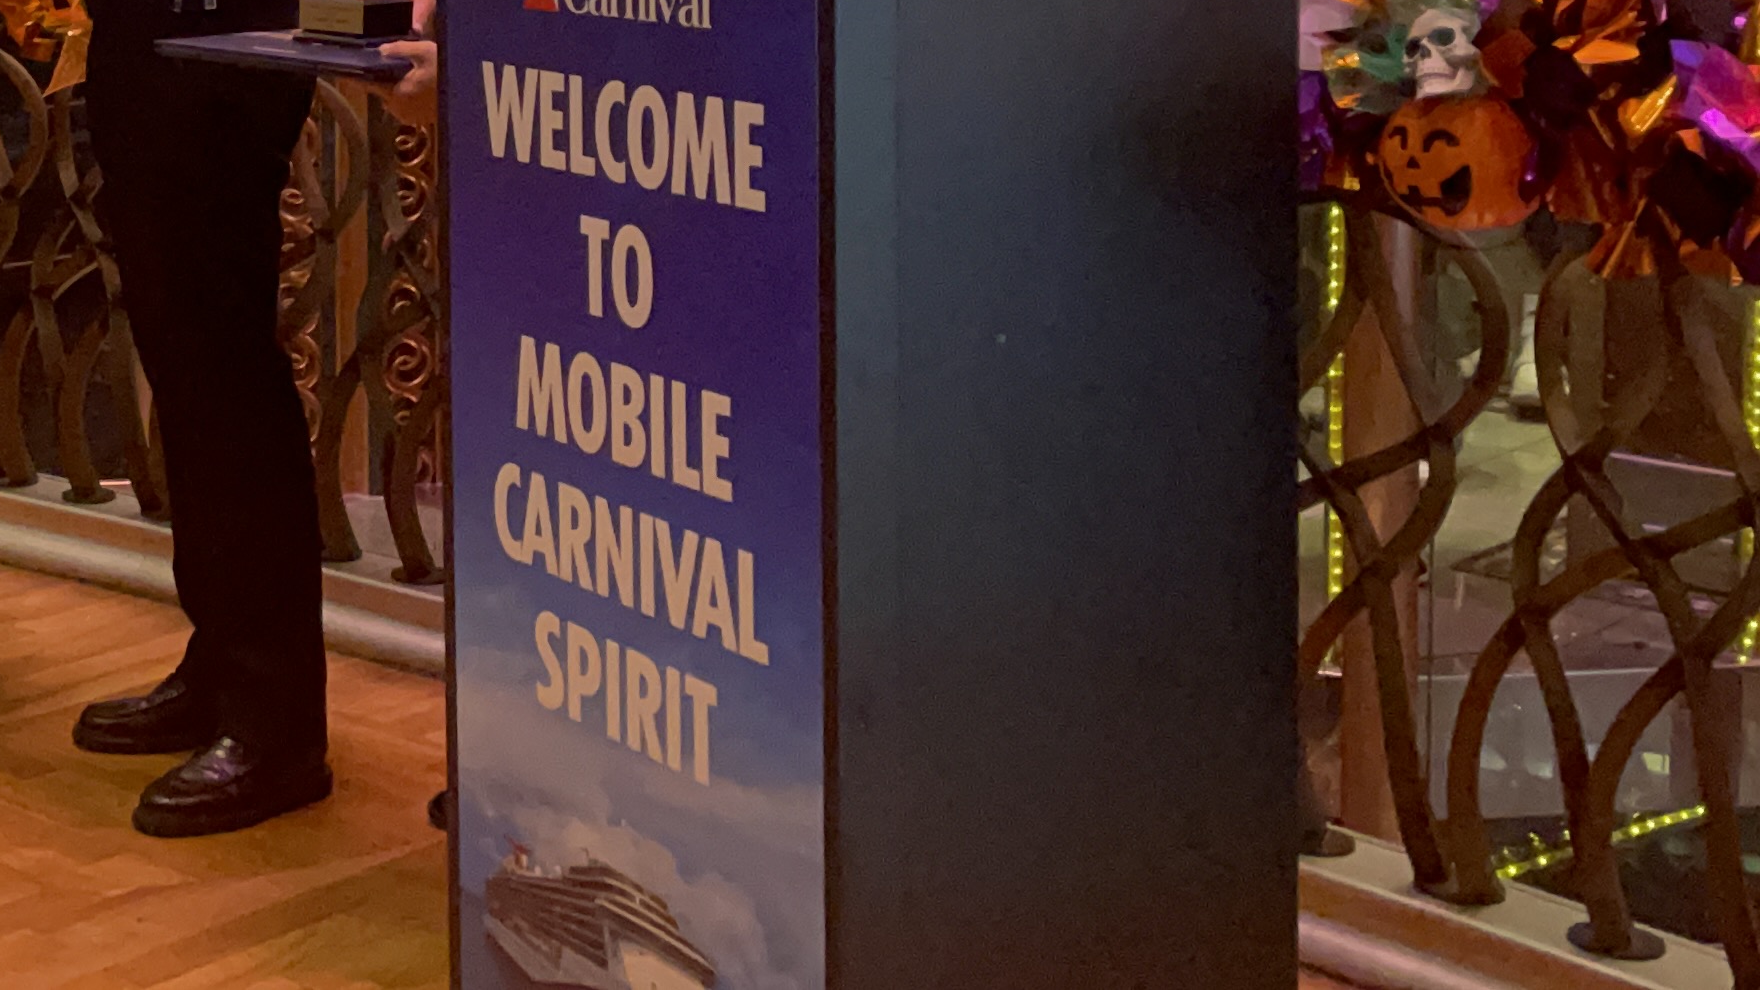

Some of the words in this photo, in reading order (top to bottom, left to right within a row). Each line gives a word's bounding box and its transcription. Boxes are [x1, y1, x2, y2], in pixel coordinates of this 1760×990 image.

[482, 60, 766, 212] WELCOME
[580, 214, 654, 329] TO
[515, 335, 733, 502] MOBILE
[494, 462, 770, 666] CARNIVAL
[534, 611, 718, 786] SPIRIT
